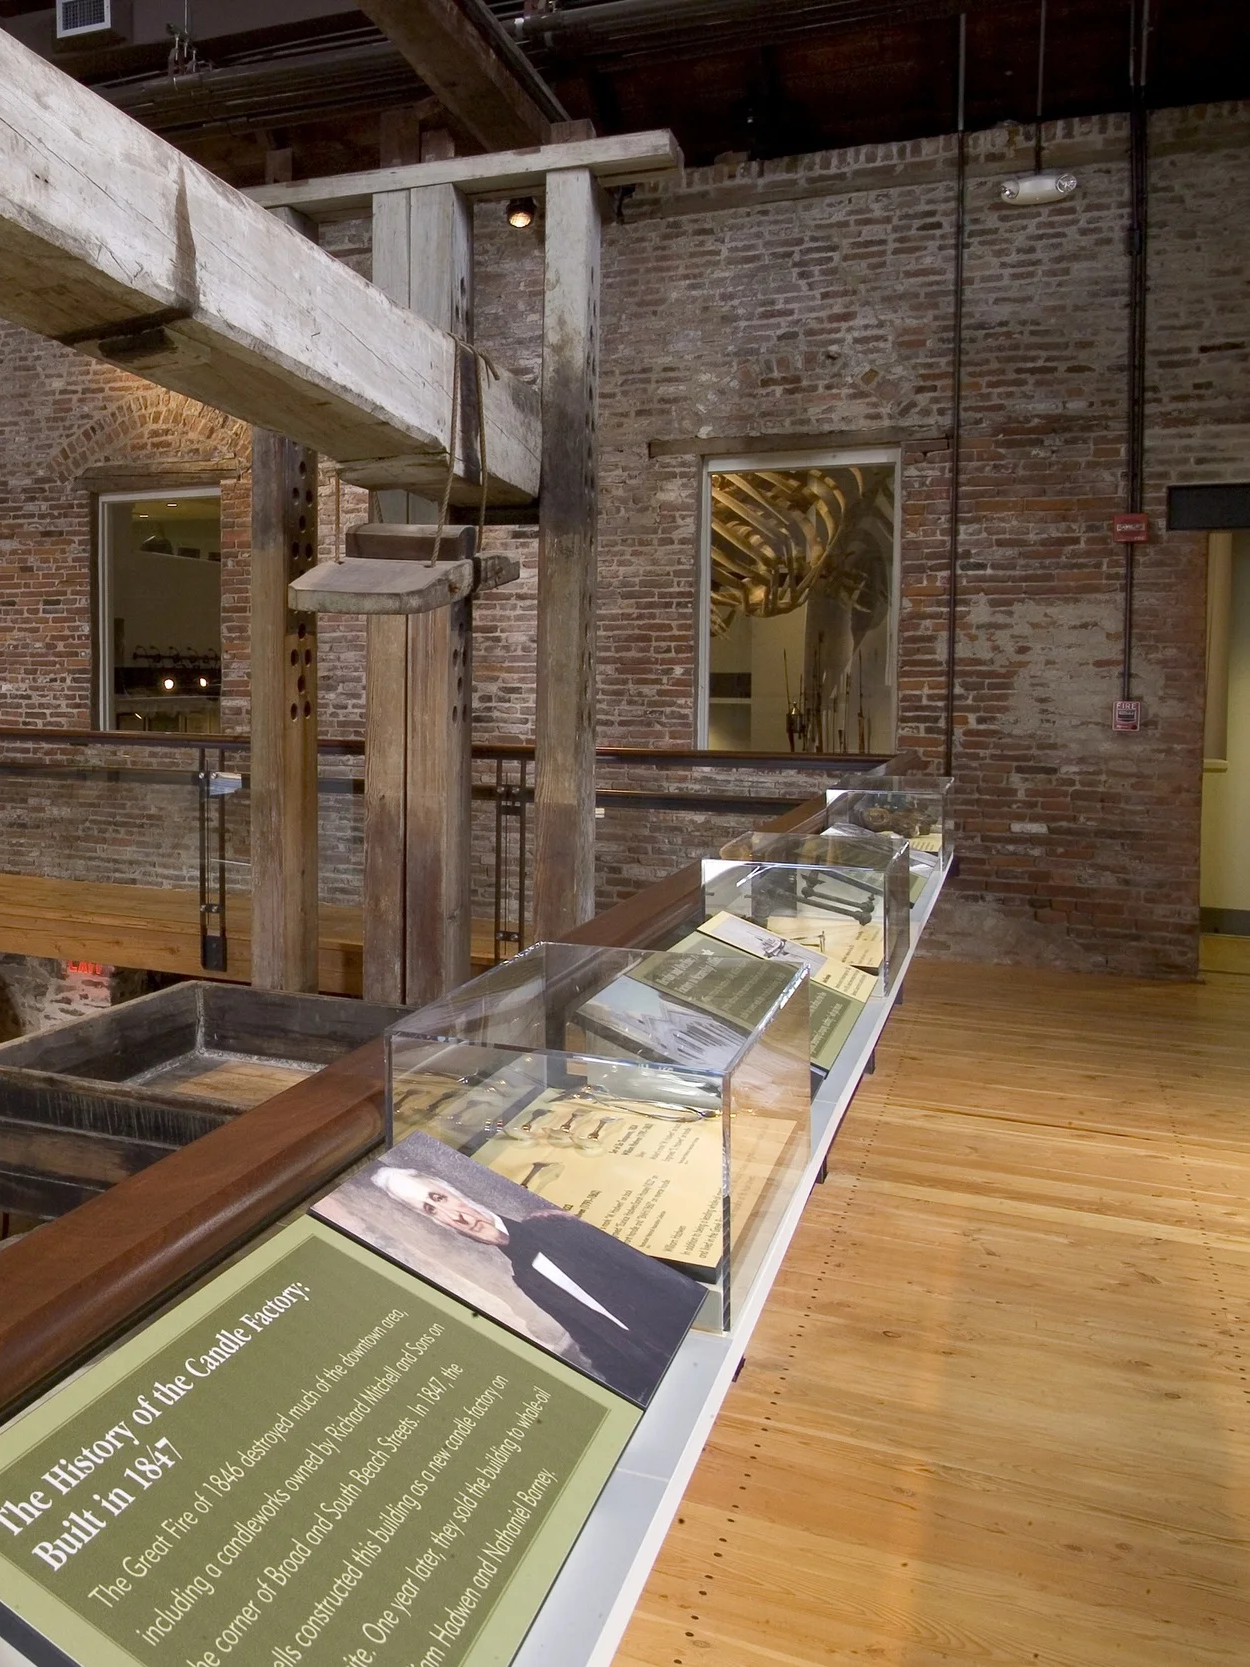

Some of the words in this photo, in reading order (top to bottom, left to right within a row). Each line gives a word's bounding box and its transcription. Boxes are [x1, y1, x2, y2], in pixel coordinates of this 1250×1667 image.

[1116, 702, 1137, 710] FIRE
[381, 1309, 410, 1329] area,
[428, 1323, 445, 1337] on
[338, 1326, 387, 1368] downtown
[395, 1348, 418, 1372] and
[405, 1333, 436, 1356] Sons
[40, 1420, 140, 1496] History
[131, 1394, 163, 1426] of
[151, 1375, 194, 1406] the
[184, 1328, 253, 1378] Candle
[238, 1282, 311, 1333] Factory:
[315, 1374, 332, 1393] of
[323, 1364, 348, 1382] the
[358, 1365, 403, 1406] Mitchell
[440, 1363, 464, 1381] the
[491, 1375, 509, 1390] on
[288, 1389, 322, 1420] much
[416, 1376, 455, 1405] 1847,
[462, 1386, 503, 1420] factory
[515, 1385, 552, 1429] whale-oil
[324, 1398, 372, 1442] Richard
[406, 1403, 430, 1418] In
[236, 1412, 295, 1468] destroyed
[310, 1437, 341, 1456] by
[376, 1417, 420, 1453] Streets.
[445, 1416, 477, 1451] candle
[505, 1427, 525, 1441] to
[284, 1448, 325, 1491] owned
[348, 1448, 391, 1487] Beach
[421, 1469, 436, 1482] a
[428, 1447, 452, 1473] new
[475, 1438, 522, 1480] building
[202, 1461, 245, 1498] 1846
[410, 1479, 429, 1497] as
[464, 1477, 491, 1499] the
[516, 1467, 558, 1508] Barney.
[30, 1508, 107, 1573] Built
[92, 1487, 137, 1517] in
[123, 1436, 183, 1491] 1847
[193, 1490, 214, 1514] of
[319, 1482, 363, 1520] South
[452, 1491, 478, 1523] sold
[160, 1511, 199, 1540] Fire
[216, 1488, 291, 1566] candleworks
[305, 1512, 334, 1546] and
[366, 1493, 422, 1544] building
[430, 1519, 466, 1549] they
[481, 1500, 532, 1563] Nathaniel
[122, 1534, 174, 1578] Great
[205, 1563, 223, 1578] a
[263, 1537, 312, 1587] Broad
[351, 1540, 382, 1568] this
[404, 1547, 447, 1582] later,
[472, 1555, 498, 1589] and
[87, 1577, 133, 1608] The
[256, 1577, 277, 1603] of
[295, 1559, 364, 1648] constructed
[390, 1577, 420, 1618] year
[135, 1575, 215, 1647] including
[215, 1599, 262, 1653] corner
[361, 1610, 400, 1644] One
[428, 1587, 482, 1648] Hadwen
